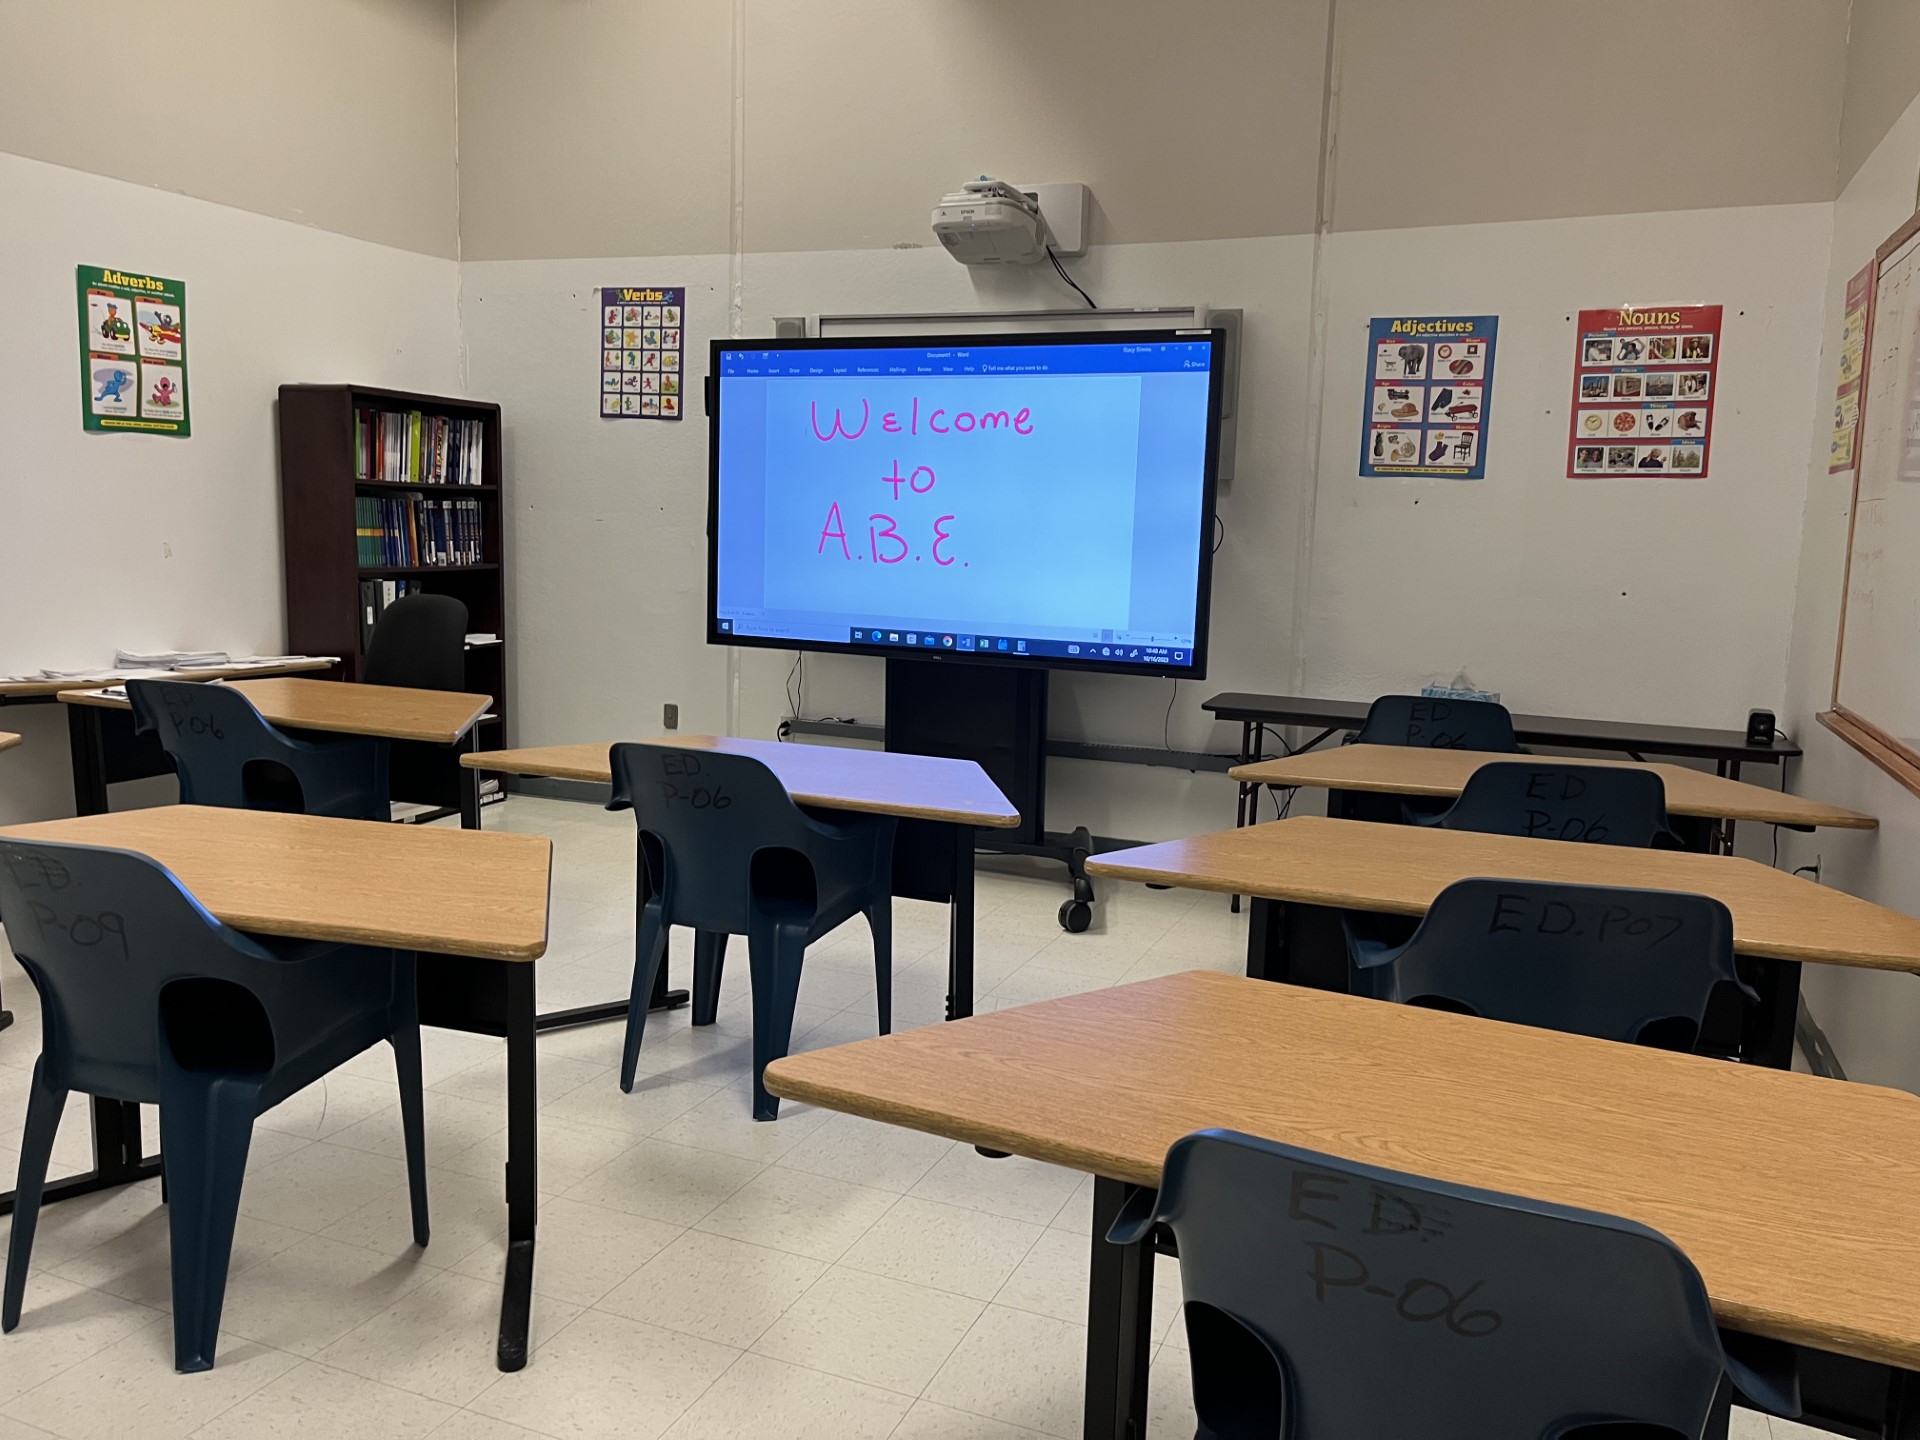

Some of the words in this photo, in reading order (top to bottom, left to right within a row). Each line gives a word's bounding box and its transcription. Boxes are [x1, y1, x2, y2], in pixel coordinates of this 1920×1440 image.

[103, 269, 164, 291] Adverbs
[623, 288, 663, 301] Verbs
[1391, 320, 1473, 336] Adjectives
[1618, 310, 1681, 326] Nouns
[811, 396, 1034, 442] Welcome
[882, 459, 936, 501] to
[818, 501, 969, 568] A.B.E.
[1303, 1240, 1501, 1338] P-06
